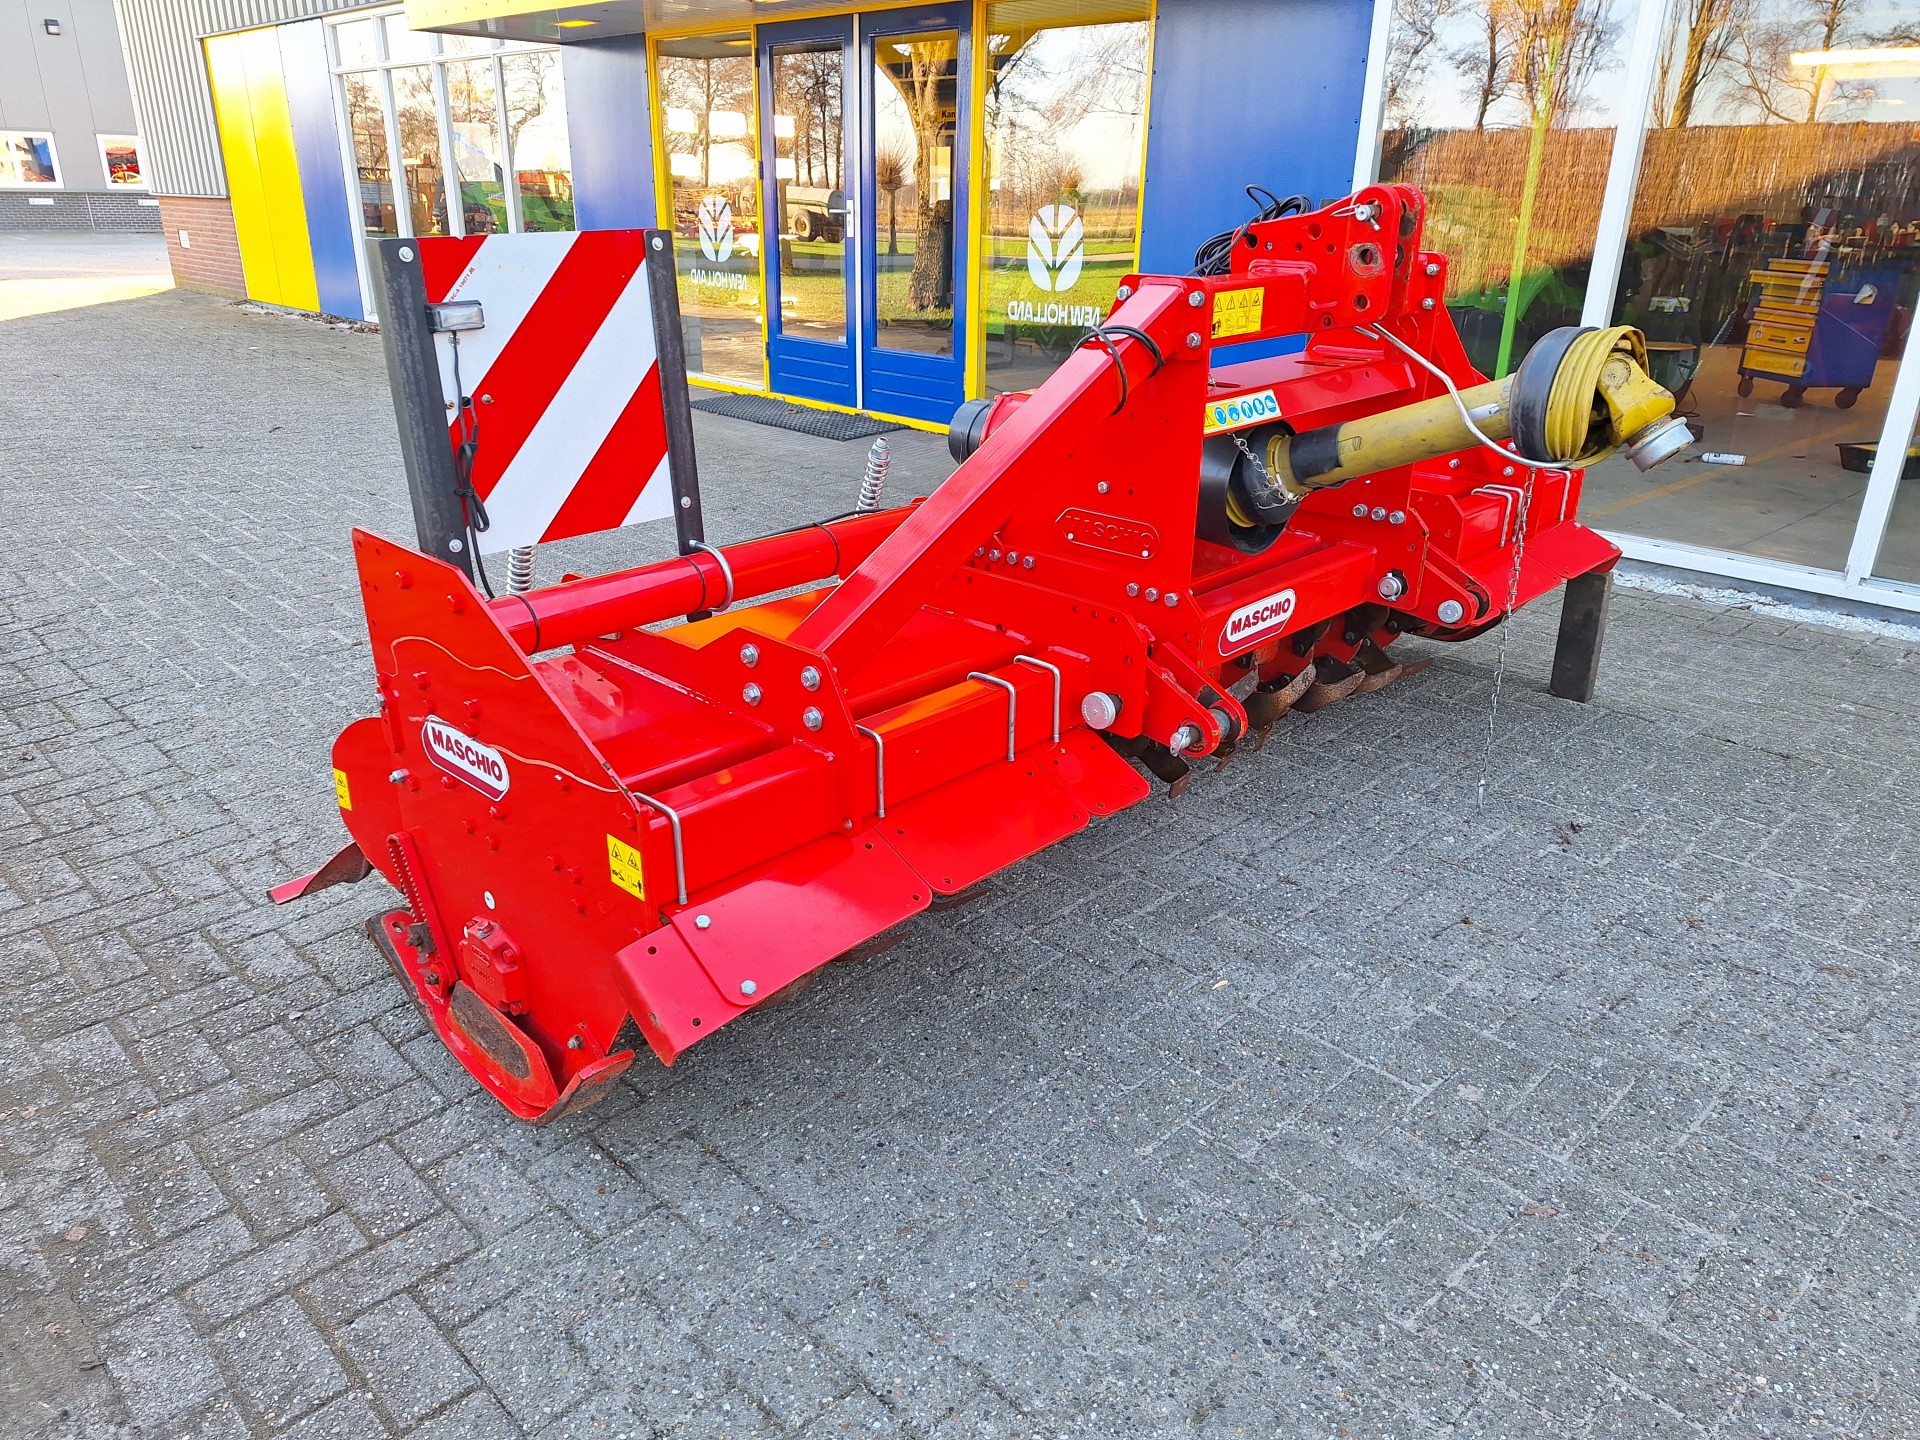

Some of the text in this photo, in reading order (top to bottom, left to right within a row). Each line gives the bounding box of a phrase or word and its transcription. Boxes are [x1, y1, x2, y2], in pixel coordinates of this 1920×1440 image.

[1062, 515, 1155, 548] MASCHIO
[1230, 597, 1291, 637] MASCHIO
[431, 725, 503, 782] MASCHIO
